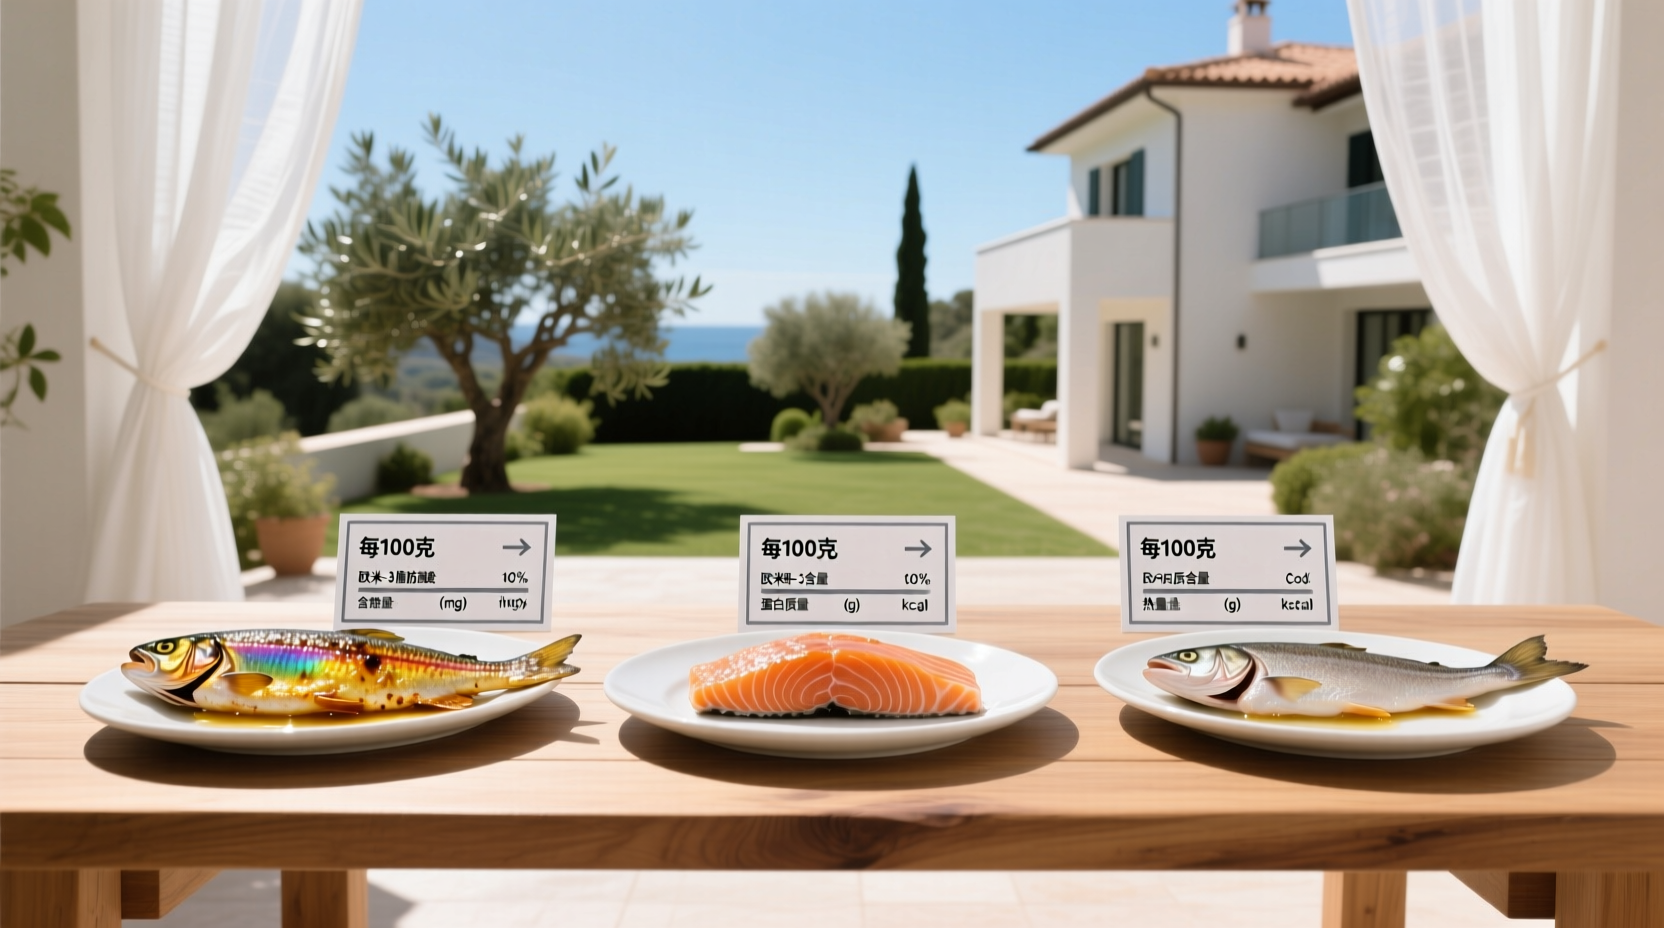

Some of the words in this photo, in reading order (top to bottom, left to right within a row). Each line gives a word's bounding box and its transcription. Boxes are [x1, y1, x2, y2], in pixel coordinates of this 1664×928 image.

[358, 535, 436, 559] 每100克
[761, 537, 839, 560] 每100克
[1139, 536, 1217, 560] 每100克
[502, 571, 529, 584] 10%
[439, 595, 468, 612] (mg)
[843, 597, 861, 614] (g)
[901, 598, 929, 613] kcal
[1224, 597, 1242, 614] (g)
